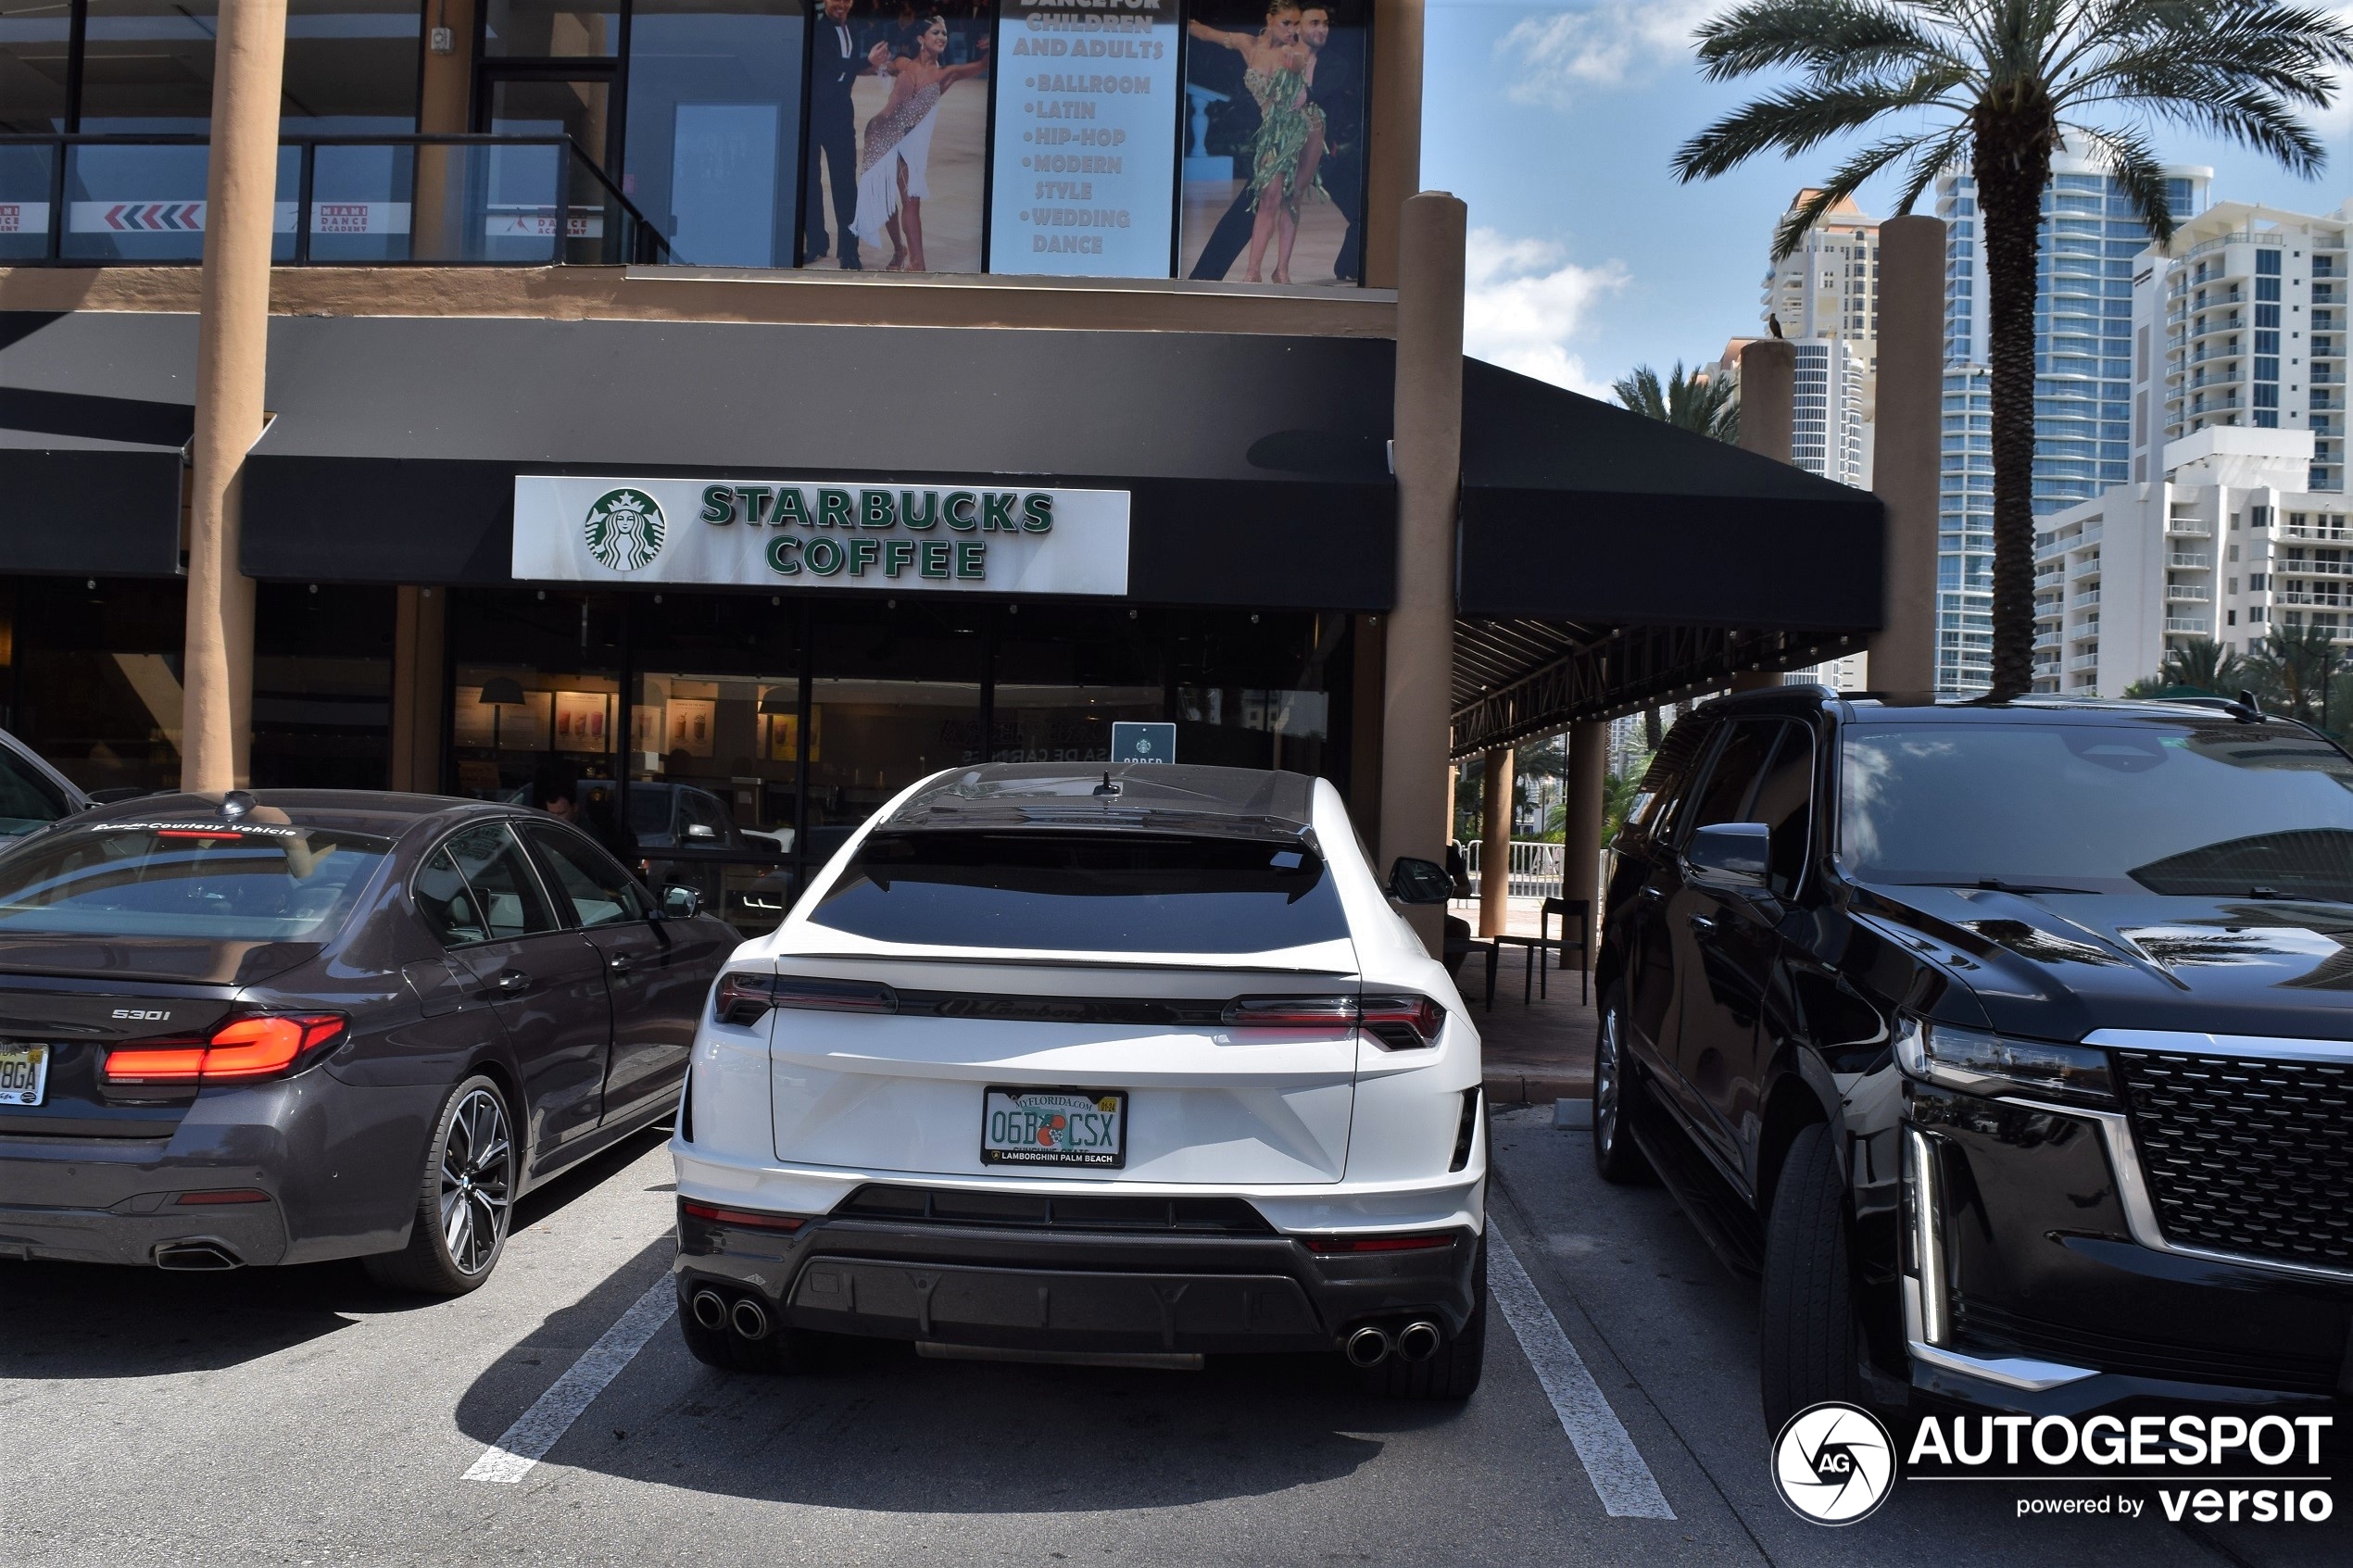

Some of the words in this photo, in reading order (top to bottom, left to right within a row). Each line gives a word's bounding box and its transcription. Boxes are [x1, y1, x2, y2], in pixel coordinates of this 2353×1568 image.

[1026, 12, 1153, 34] CHILDREN
[1013, 37, 1067, 56] AND
[1070, 38, 1164, 60] ADULTS
[1038, 74, 1151, 94] BALLROOM
[1036, 101, 1096, 119] LATIN
[1035, 127, 1126, 147] HIP-HOP
[1034, 155, 1122, 174] MODERN
[1035, 181, 1092, 200] STYLE
[321, 207, 368, 216] MIAMI
[321, 217, 368, 225] DANCE
[1032, 208, 1131, 229] WEDDING
[538, 219, 587, 228] DACE
[1033, 235, 1103, 255] DANCE
[699, 483, 1054, 534] STARBUCKS
[764, 534, 987, 581] COFFEE
[147, 822, 225, 832] Courtesy
[231, 824, 297, 836] Vehicle
[1068, 1113, 1114, 1147] CSX
[1001, 1151, 1059, 1161] LAMBORGHINI
[1060, 1154, 1082, 1162] PALM
[1085, 1155, 1113, 1163] BEACH
